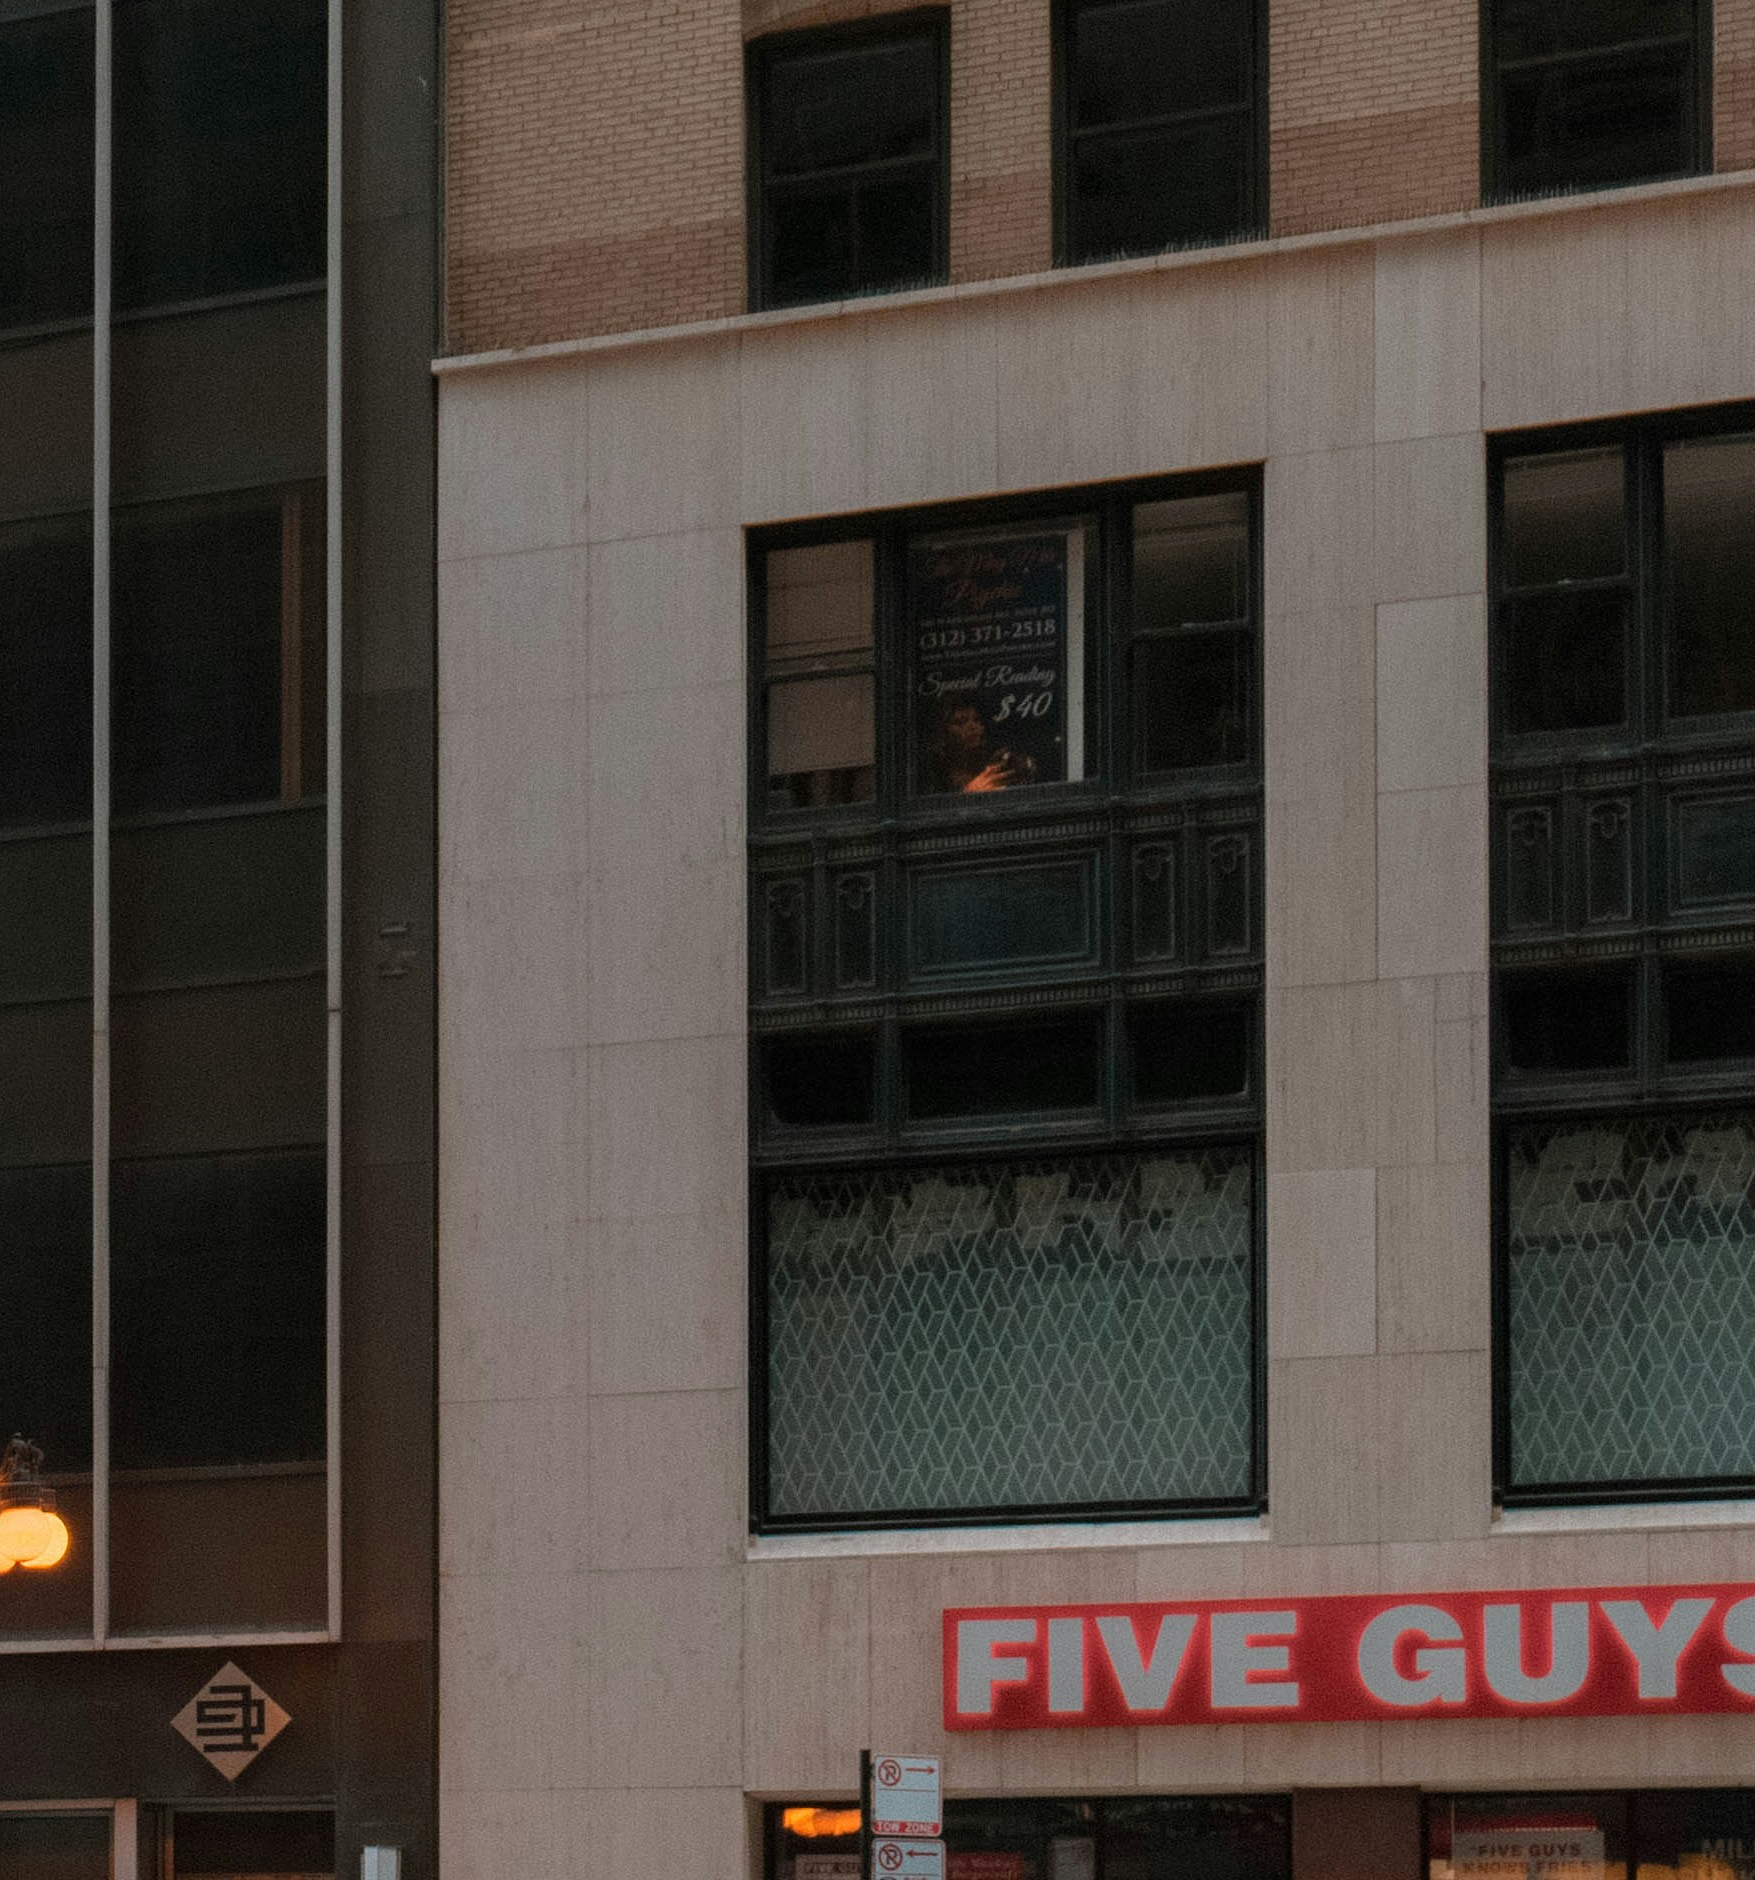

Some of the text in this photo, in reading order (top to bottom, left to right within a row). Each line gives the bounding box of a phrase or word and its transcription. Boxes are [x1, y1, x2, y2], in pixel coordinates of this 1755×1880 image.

[919, 629, 967, 650] (312)
[955, 1609, 1301, 1715] FIVE
[876, 1822, 935, 1834] TOW ZONE
[1478, 1842, 1582, 1858] FIVE GUYS
